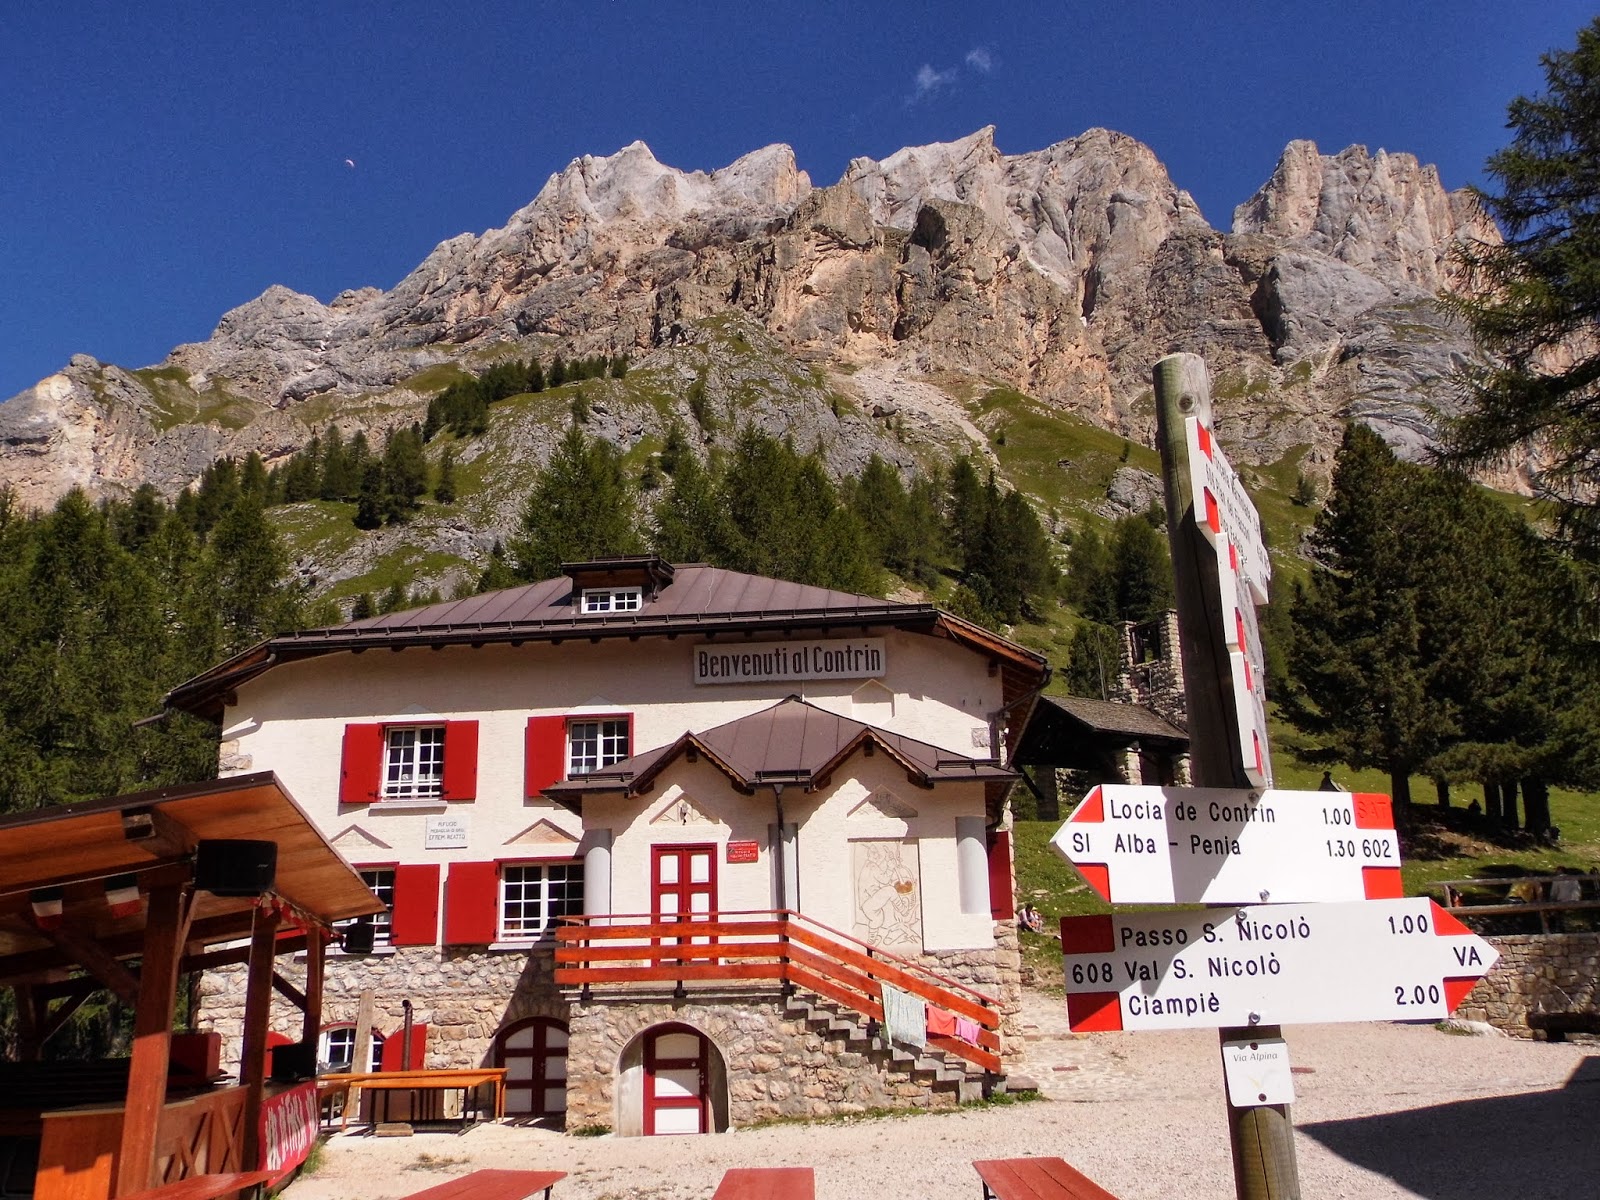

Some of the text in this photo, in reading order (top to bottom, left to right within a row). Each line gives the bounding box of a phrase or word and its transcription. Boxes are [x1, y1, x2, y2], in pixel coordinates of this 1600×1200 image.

[699, 644, 881, 678] Benvenuti al Contrin
[1110, 799, 1351, 825] Locia de Contrin 1.00
[1114, 833, 1156, 853] Alba
[1191, 834, 1241, 855] Penia
[1326, 839, 1355, 857] 1.30
[1362, 838, 1392, 858] 602
[1120, 914, 1428, 947] Passo S. Nicolò 1.00
[1072, 946, 1483, 984] 608 Val S. Nicolò VA
[1128, 984, 1440, 1017] Ciampiè 2.00
[1233, 1051, 1278, 1062] Via Alpina
